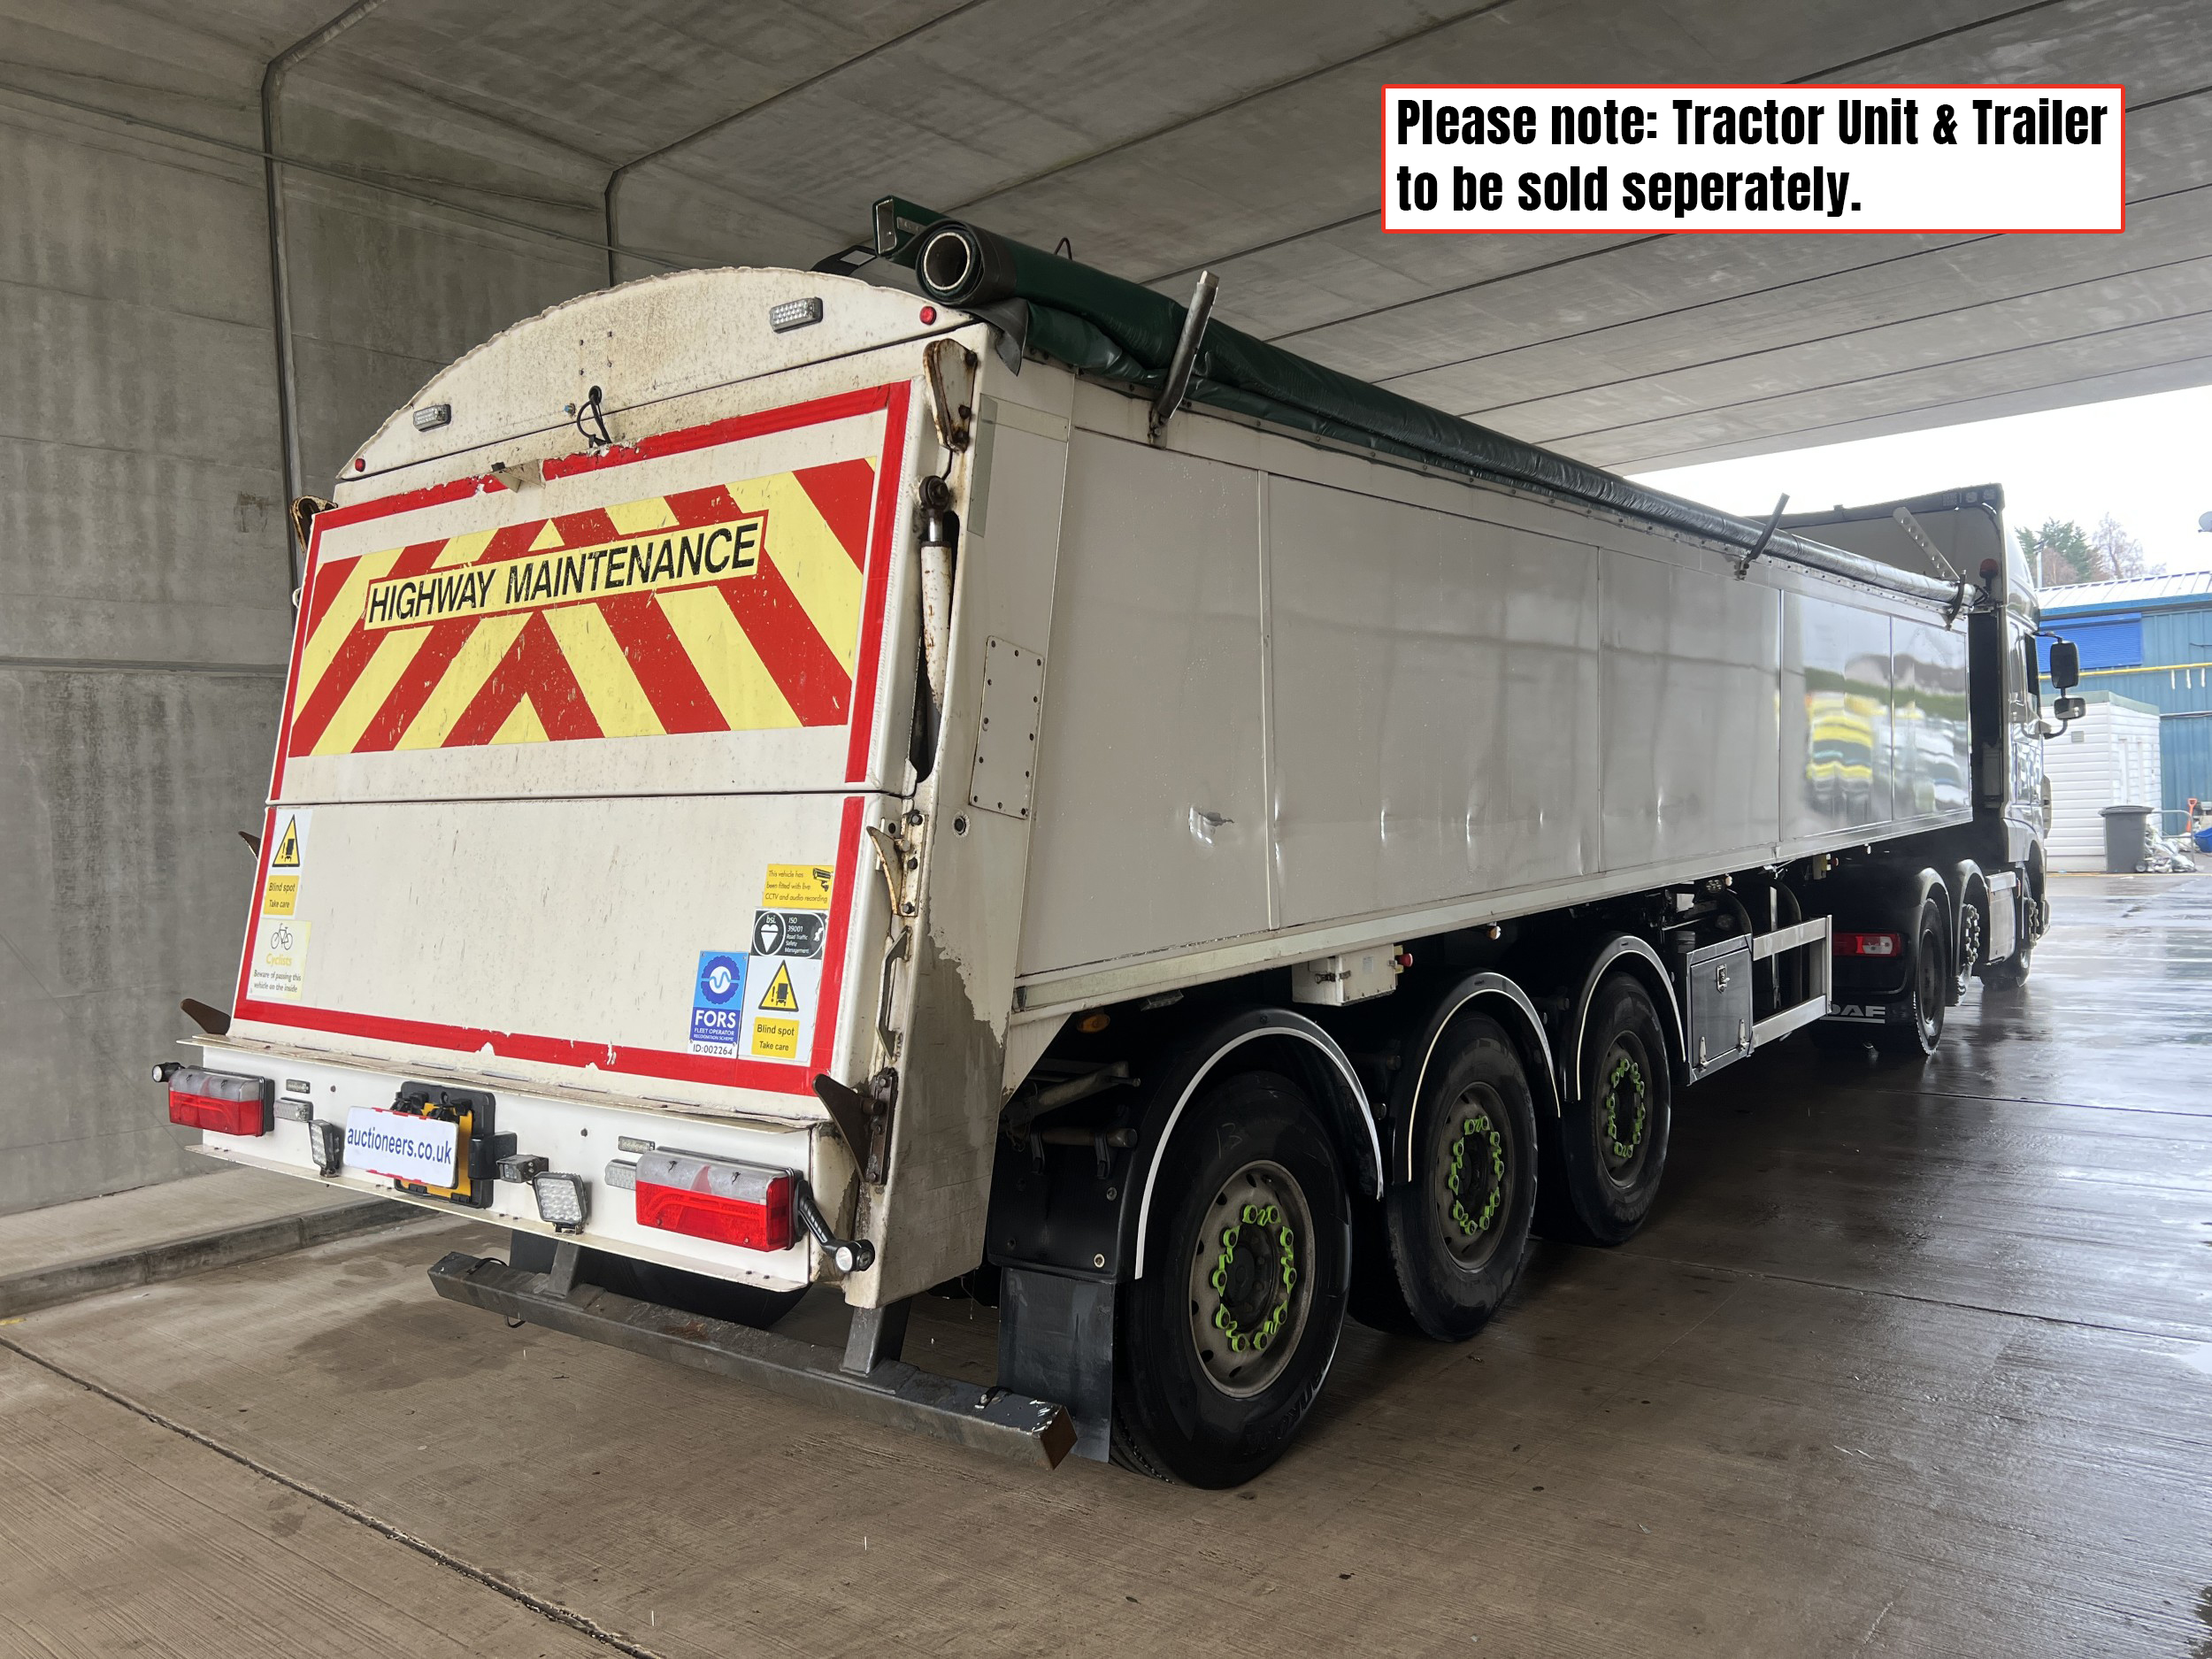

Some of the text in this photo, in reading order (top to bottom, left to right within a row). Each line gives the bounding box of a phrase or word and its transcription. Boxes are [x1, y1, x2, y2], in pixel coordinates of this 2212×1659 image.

[368, 522, 759, 624] HIGHWAY MAINTENANCE
[269, 882, 295, 893] Blind spot
[270, 900, 279, 908] Take
[805, 895, 828, 904] recording
[266, 953, 292, 967] Cyclists
[254, 969, 269, 978] Beware
[275, 973, 292, 983] passing
[292, 973, 301, 982] this
[254, 981, 269, 990] vehicle
[284, 984, 298, 993] inside
[695, 1010, 736, 1029] FORS
[757, 1024, 795, 1037] Blind spot
[694, 1044, 733, 1056] ID:002264
[759, 1041, 774, 1049] Take
[347, 1126, 452, 1164] auctioneers.co.uk
